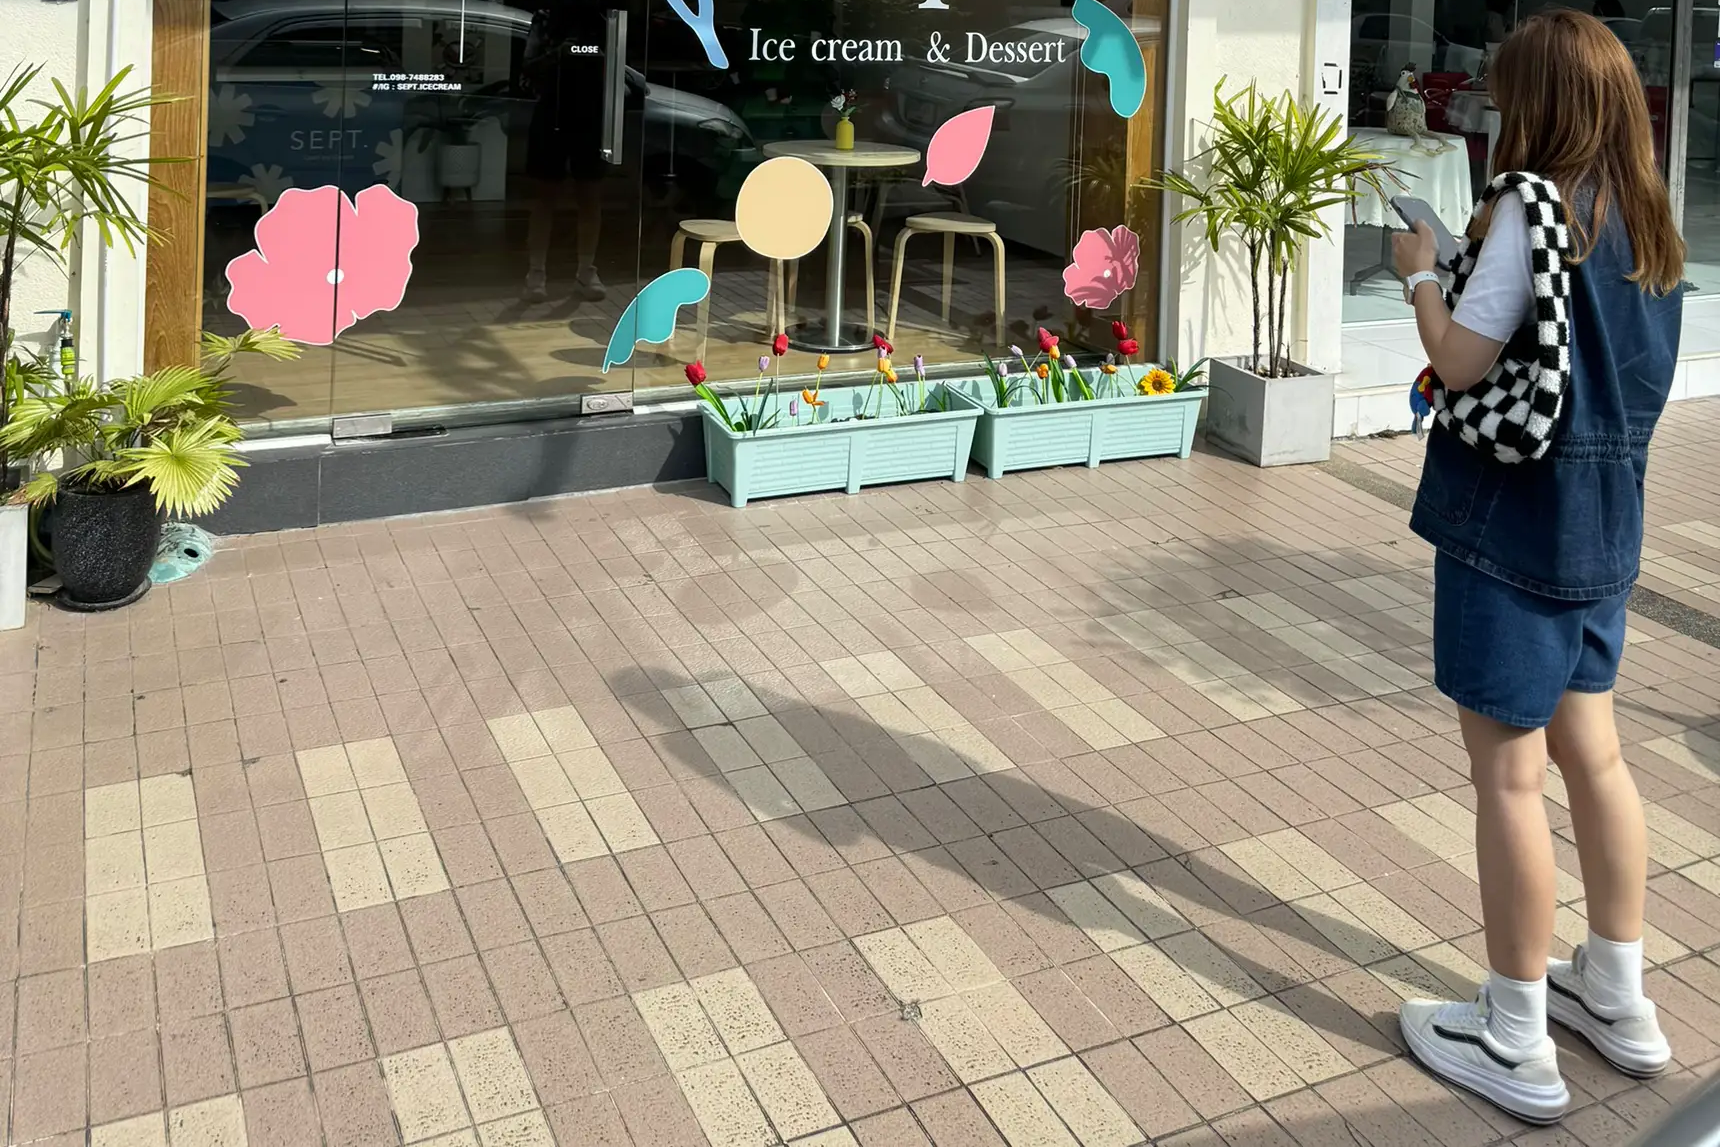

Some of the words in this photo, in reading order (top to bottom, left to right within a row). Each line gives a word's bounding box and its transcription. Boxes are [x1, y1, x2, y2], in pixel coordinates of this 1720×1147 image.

[570, 45, 599, 54] CLOSE
[748, 28, 796, 62] Ice
[811, 36, 904, 63] cream
[926, 30, 951, 64] &
[965, 31, 1067, 64] Dessert
[396, 83, 462, 91] SEPT.ICECREAM
[290, 129, 368, 151] SEPT.
